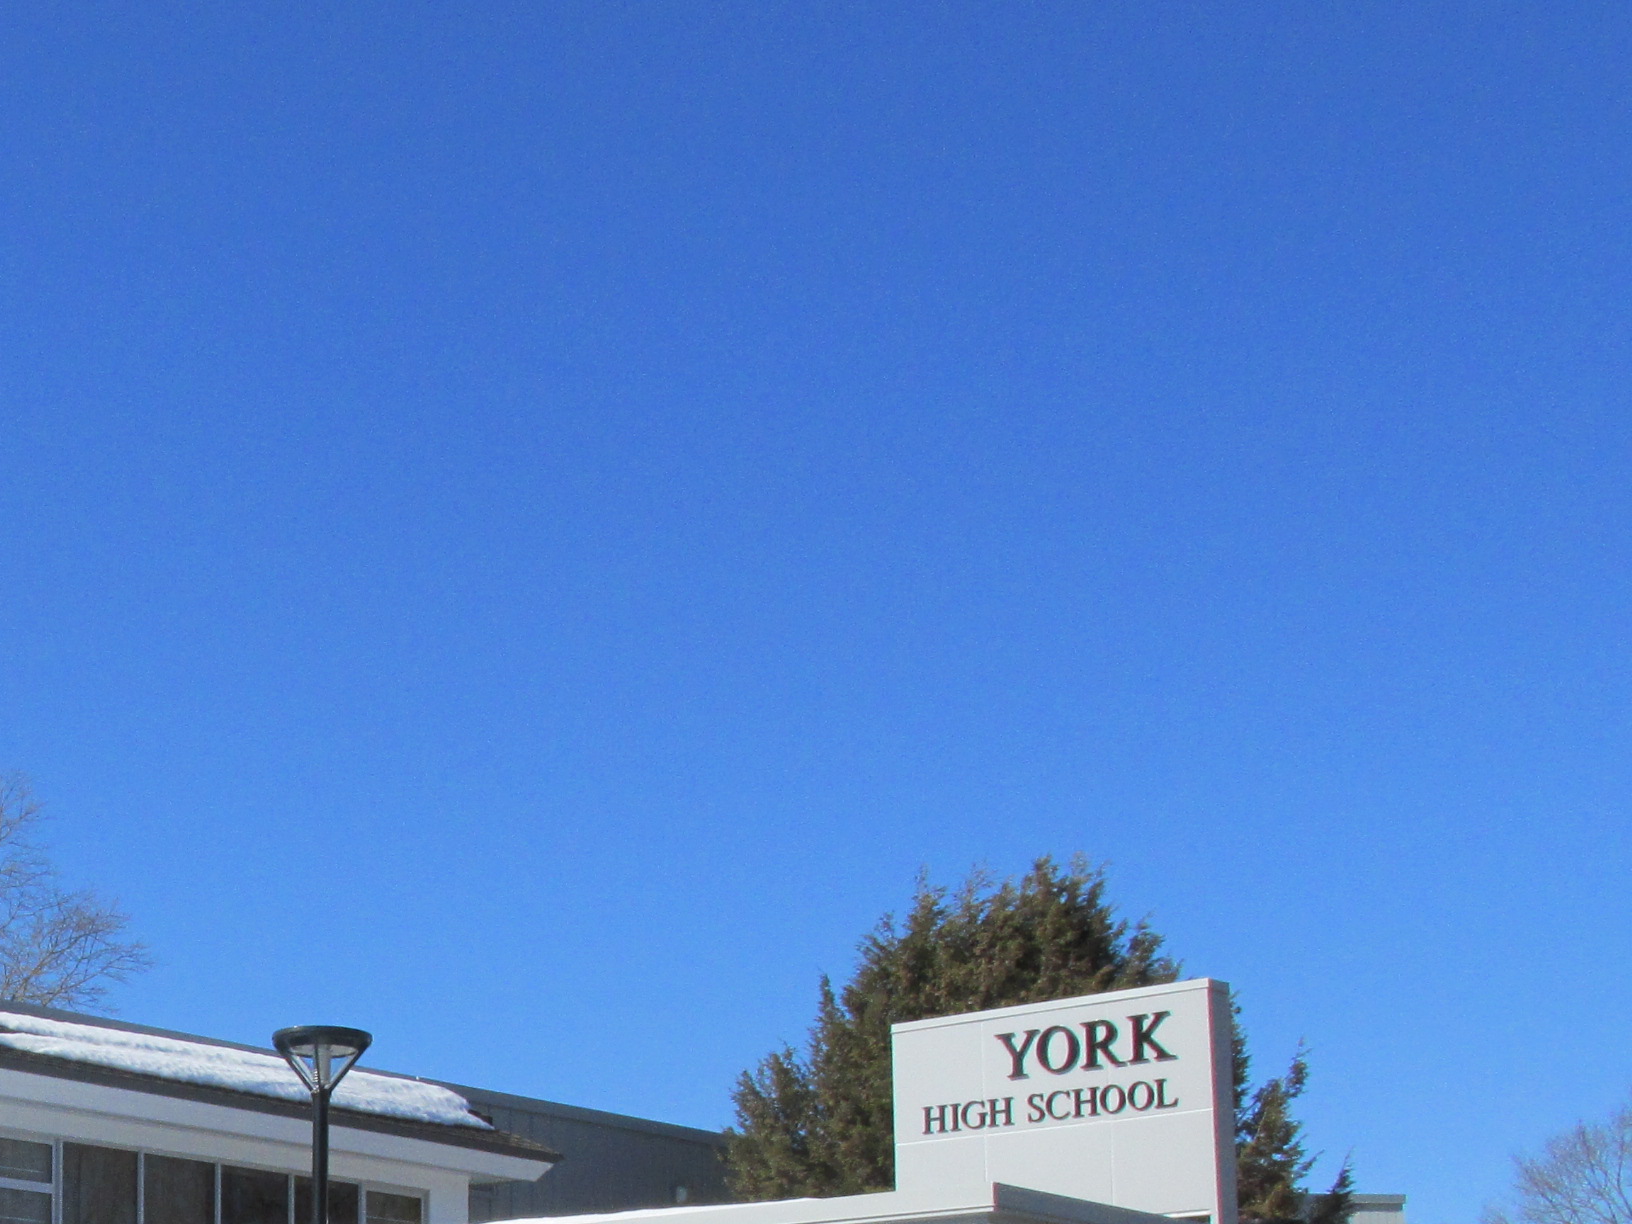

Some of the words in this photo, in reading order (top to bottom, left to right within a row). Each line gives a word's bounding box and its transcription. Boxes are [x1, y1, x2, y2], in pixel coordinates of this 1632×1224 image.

[995, 1011, 1178, 1080] YORK
[922, 1097, 1015, 1134] HIGH
[1028, 1079, 1179, 1123] SCHOOL
